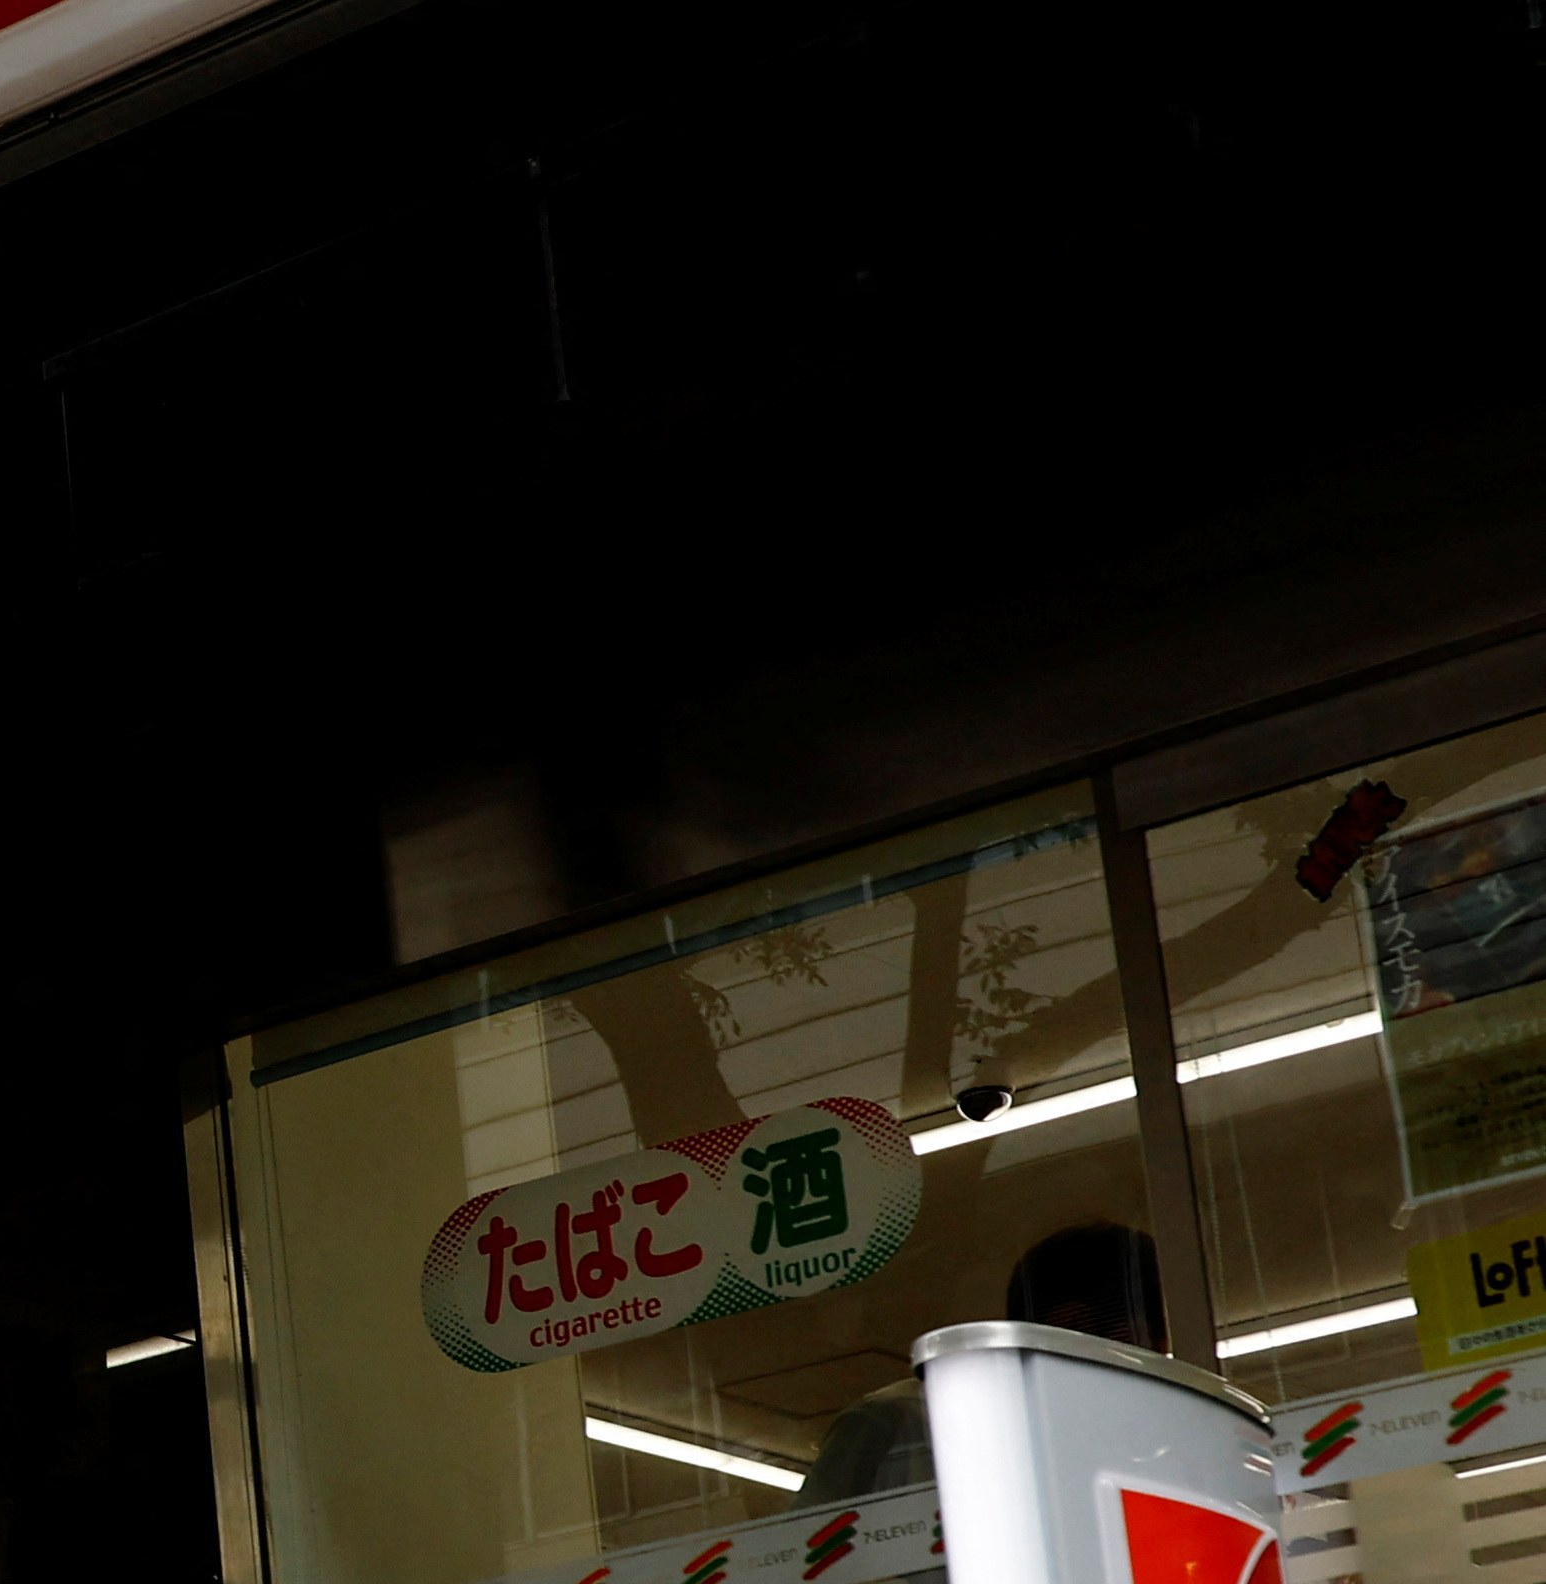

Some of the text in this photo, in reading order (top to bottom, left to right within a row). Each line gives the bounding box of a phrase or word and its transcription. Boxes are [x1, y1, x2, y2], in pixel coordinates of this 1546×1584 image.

[742, 1125, 851, 1257] 酒
[476, 1170, 703, 1326] たばこ
[764, 1245, 858, 1290] liquor
[528, 1291, 664, 1352] cigarette
